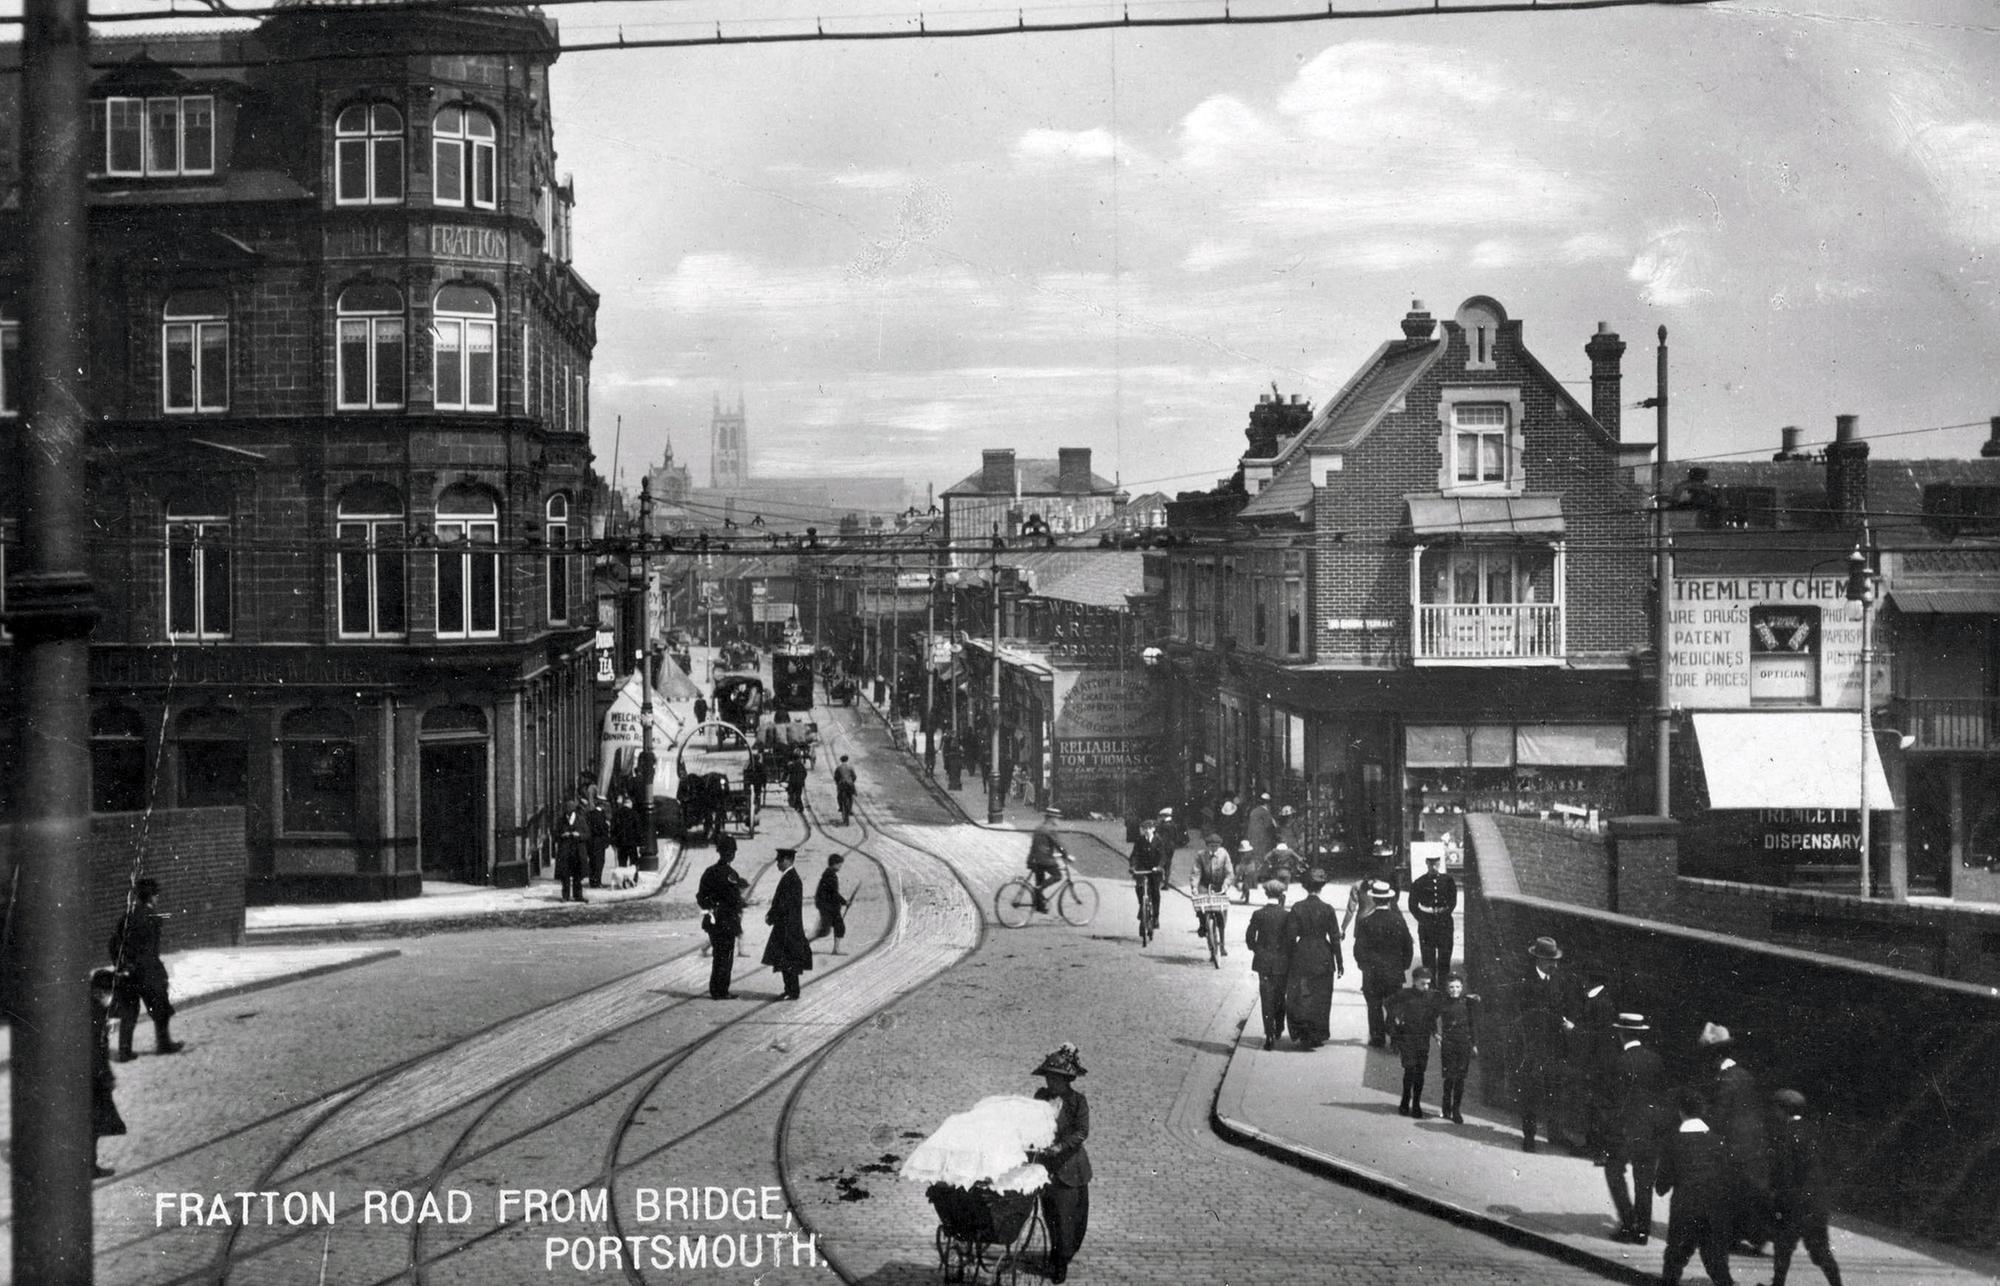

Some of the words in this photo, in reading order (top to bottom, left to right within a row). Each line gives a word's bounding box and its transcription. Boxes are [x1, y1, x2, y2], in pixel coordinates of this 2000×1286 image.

[432, 224, 508, 258] FRATTON
[1674, 579, 1787, 601] TREMLETT
[1793, 579, 1882, 600] CHEMT
[1668, 609, 1696, 624] URE
[1704, 609, 1748, 624] DRUGS
[1675, 630, 1732, 645] PATENT
[598, 657, 614, 674] TEA
[1668, 651, 1744, 666] MEDICINES
[1668, 672, 1698, 687] TORE
[1705, 672, 1748, 687] PRICES
[1760, 670, 1807, 679] OPTICIAN
[613, 723, 636, 732] TEA
[603, 732, 631, 742] DINING
[1059, 740, 1131, 754] RELIABLE
[1059, 754, 1086, 766] TOM
[1093, 754, 1142, 767] THOMAS
[1764, 832, 1861, 850] DISPENSARY
